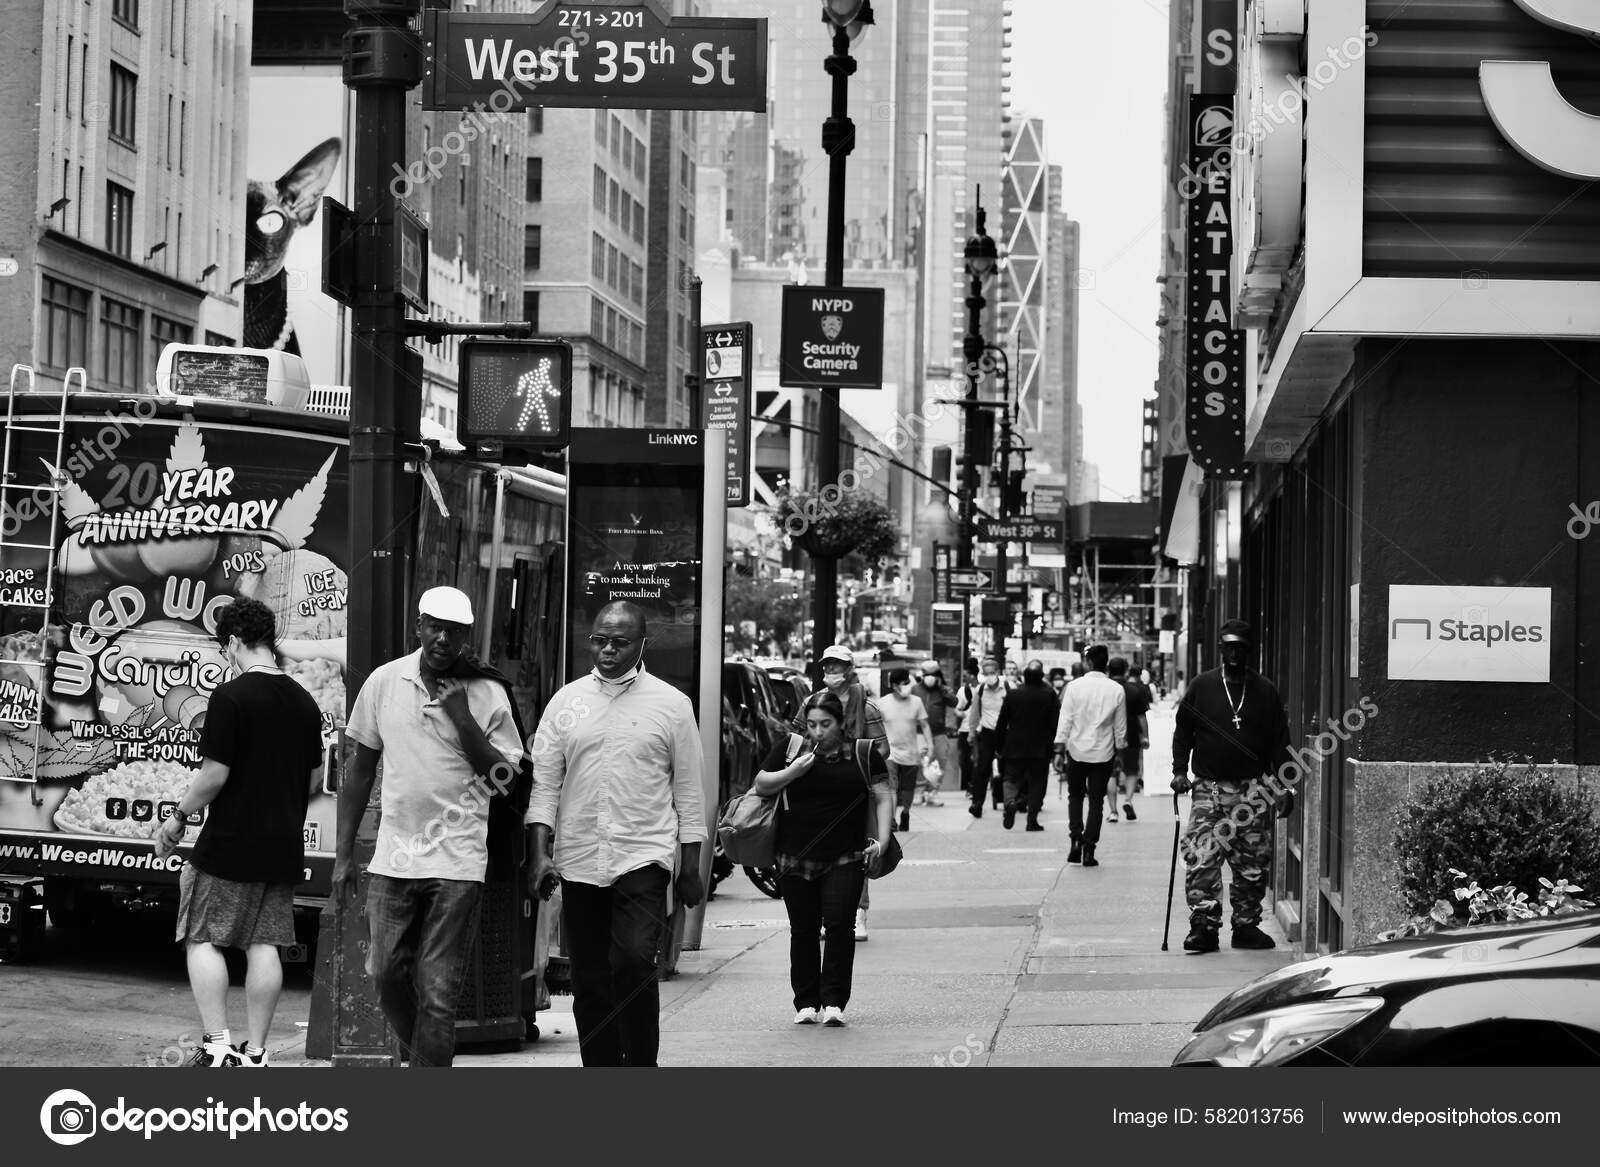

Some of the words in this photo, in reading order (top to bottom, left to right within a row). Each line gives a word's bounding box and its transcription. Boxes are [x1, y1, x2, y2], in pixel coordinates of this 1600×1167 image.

[557, 10, 592, 28] 271
[610, 11, 644, 28] 201
[1206, 29, 1233, 66] S
[464, 38, 580, 82] West
[593, 37, 676, 84] 35th
[690, 41, 736, 86] St
[1205, 171, 1228, 255] EAT
[811, 298, 853, 312] NYPD
[802, 340, 860, 359] Security
[1203, 268, 1229, 418] TACOS
[803, 355, 858, 370] Camera
[648, 433, 698, 445] LinkNYC
[101, 461, 157, 508] 20
[162, 466, 235, 502] YEAR
[78, 498, 278, 545] ANNIVERSARY
[987, 524, 1018, 537] West
[1043, 525, 1056, 538] St
[613, 561, 622, 570] A
[623, 563, 640, 572] new
[640, 562, 657, 574] way
[304, 568, 336, 595] ICE
[600, 575, 610, 584] to
[611, 573, 633, 585] make
[635, 573, 670, 588] banking
[609, 587, 661, 600] personalized
[1438, 618, 1544, 648] Staples
[114, 740, 149, 759] THE
